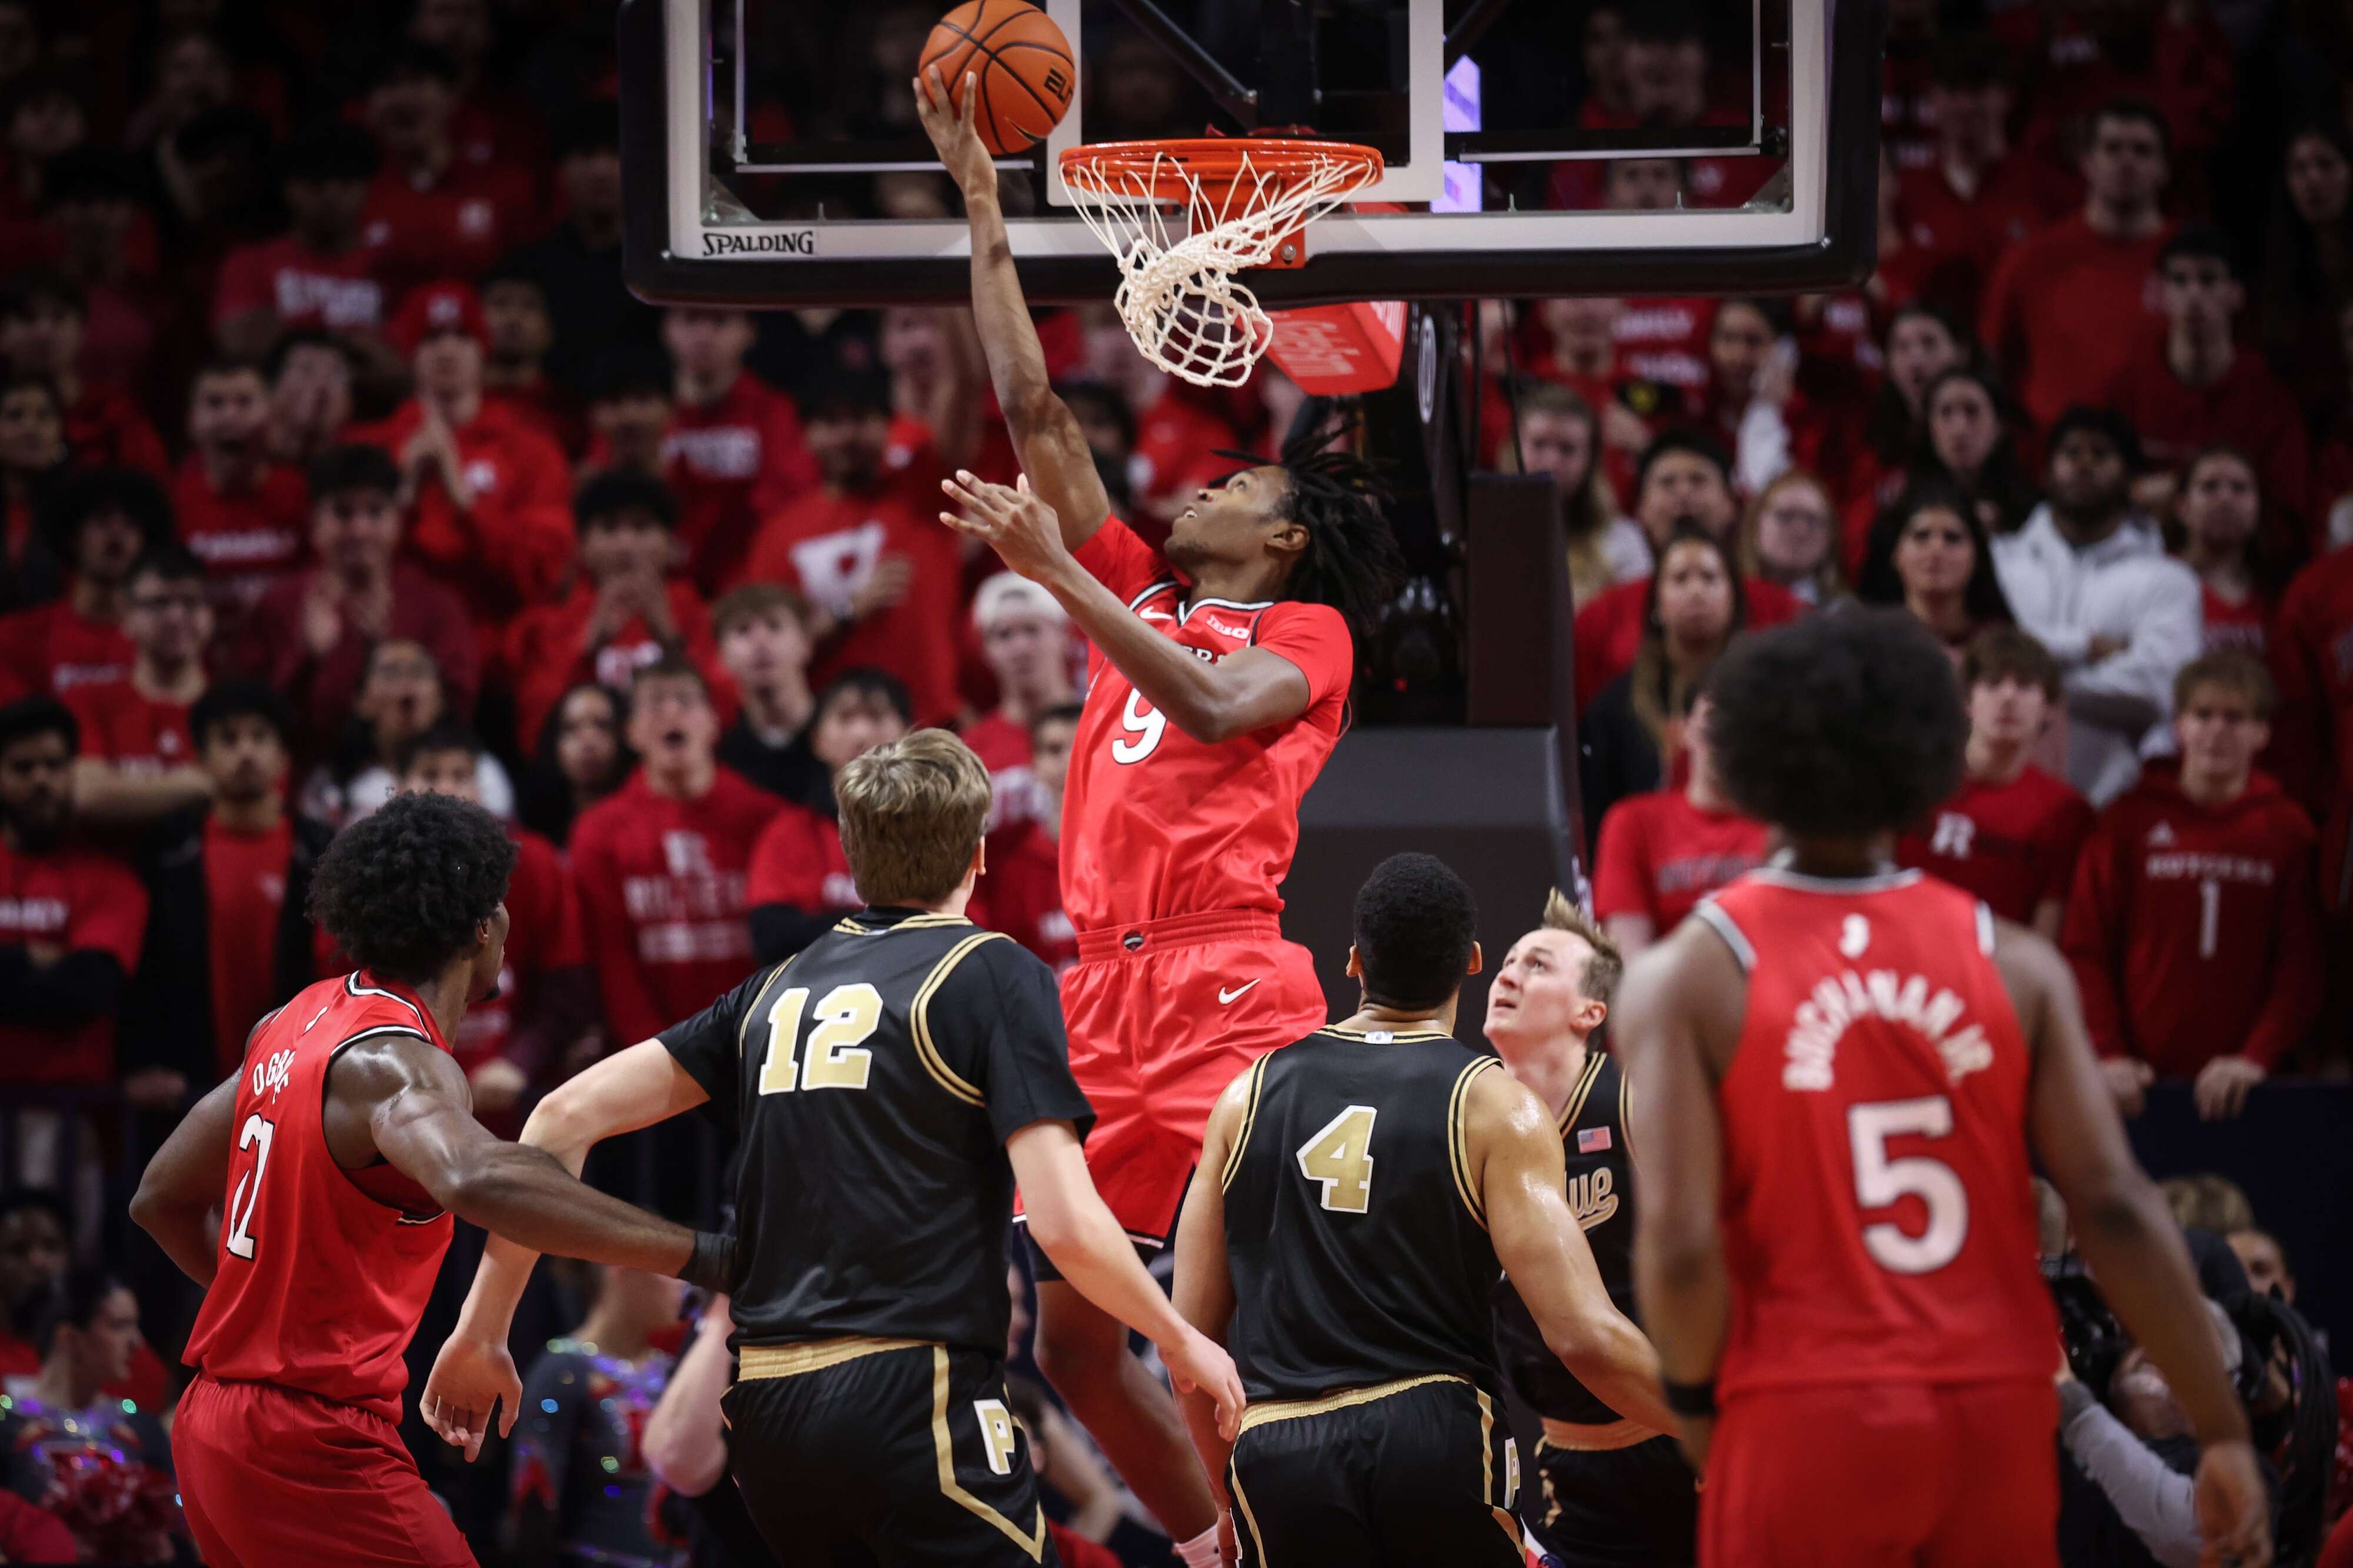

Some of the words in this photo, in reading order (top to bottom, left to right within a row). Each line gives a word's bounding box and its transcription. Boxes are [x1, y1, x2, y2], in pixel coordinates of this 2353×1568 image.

[703, 231, 814, 256] SPALDING
[1112, 686, 1166, 764] 9
[758, 982, 884, 1096] 12
[1296, 1105, 1378, 1214] 4
[1847, 1093, 1969, 1275] 5
[973, 1398, 1015, 1475] P
[1504, 1436, 1521, 1510] P
